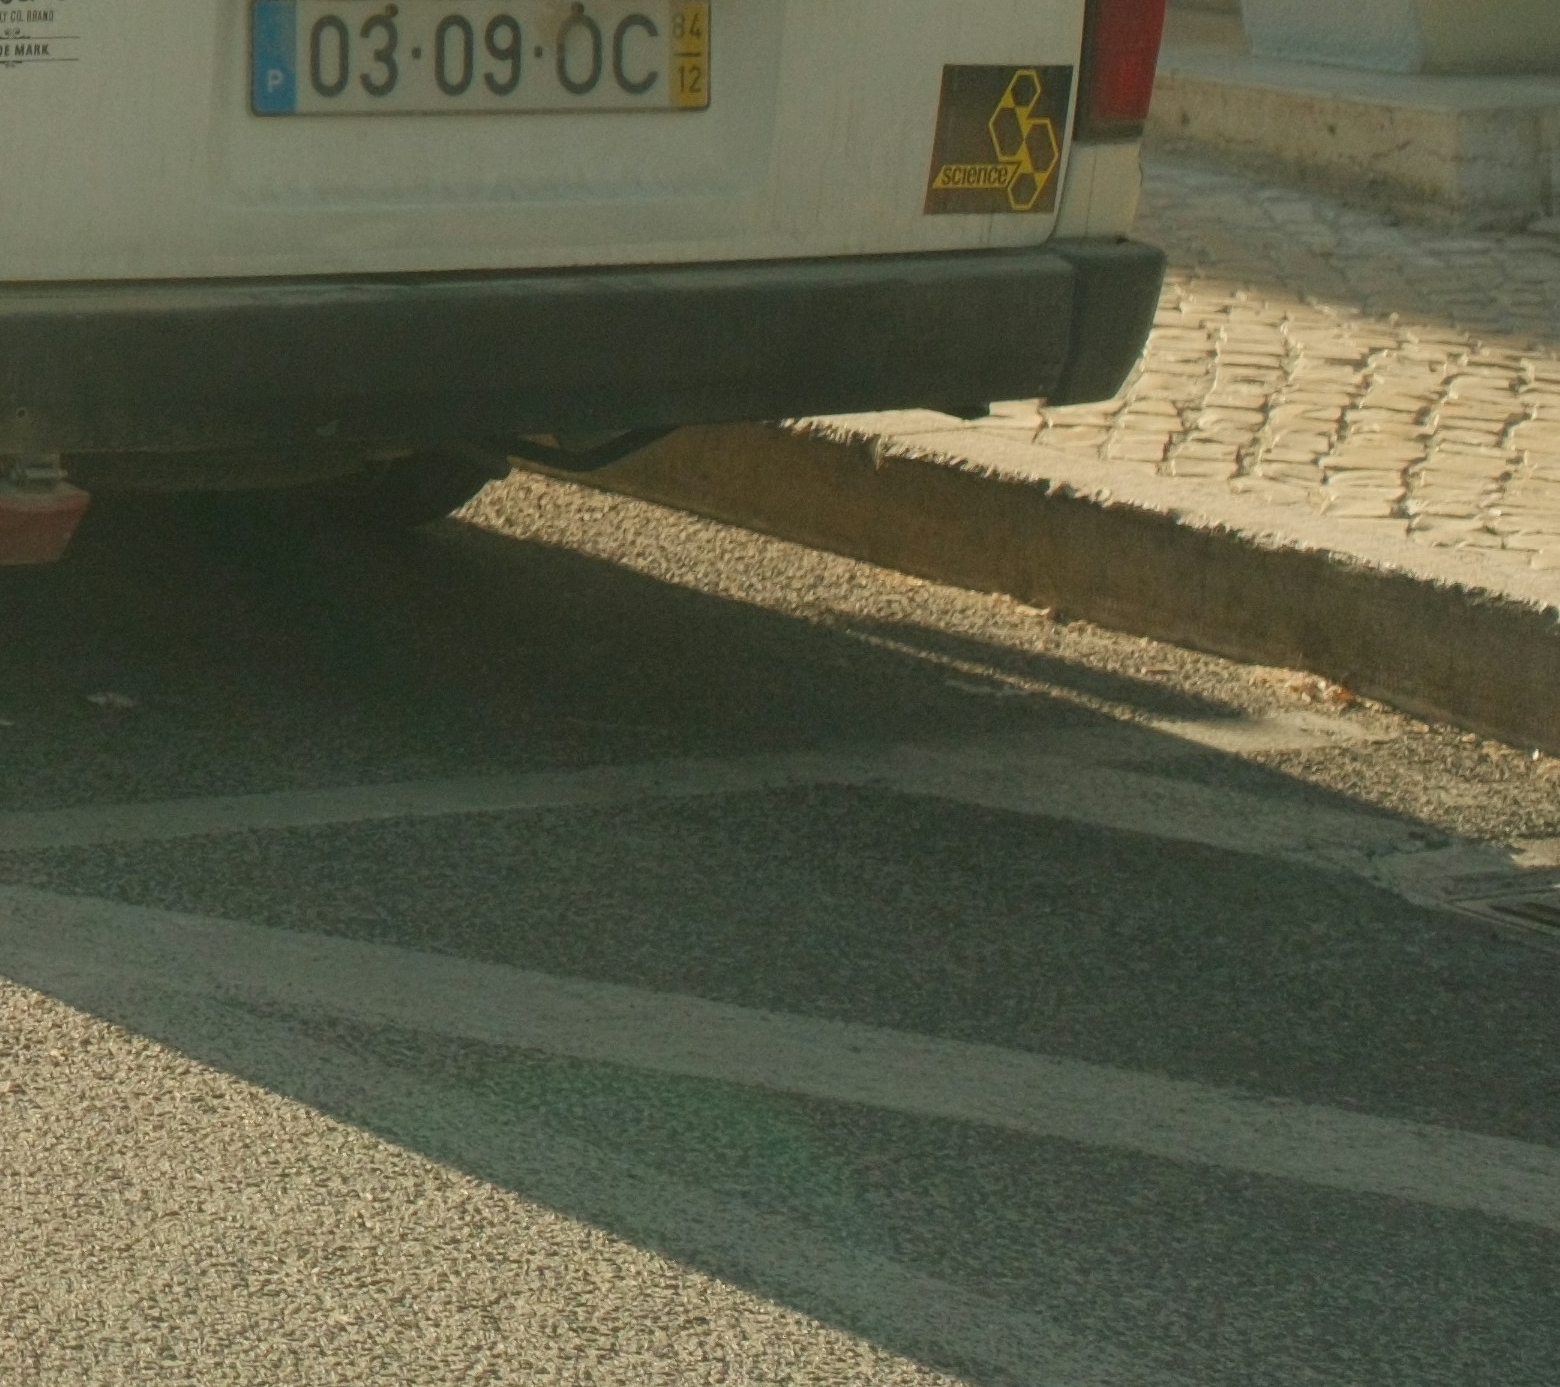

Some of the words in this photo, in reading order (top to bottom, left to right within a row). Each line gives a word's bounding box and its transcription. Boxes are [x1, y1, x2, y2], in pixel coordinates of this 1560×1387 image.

[26, 9, 55, 23] BRAND
[671, 12, 701, 39] 84
[14, 42, 50, 56] MARK
[678, 65, 701, 94] 12
[942, 165, 1008, 186] science
